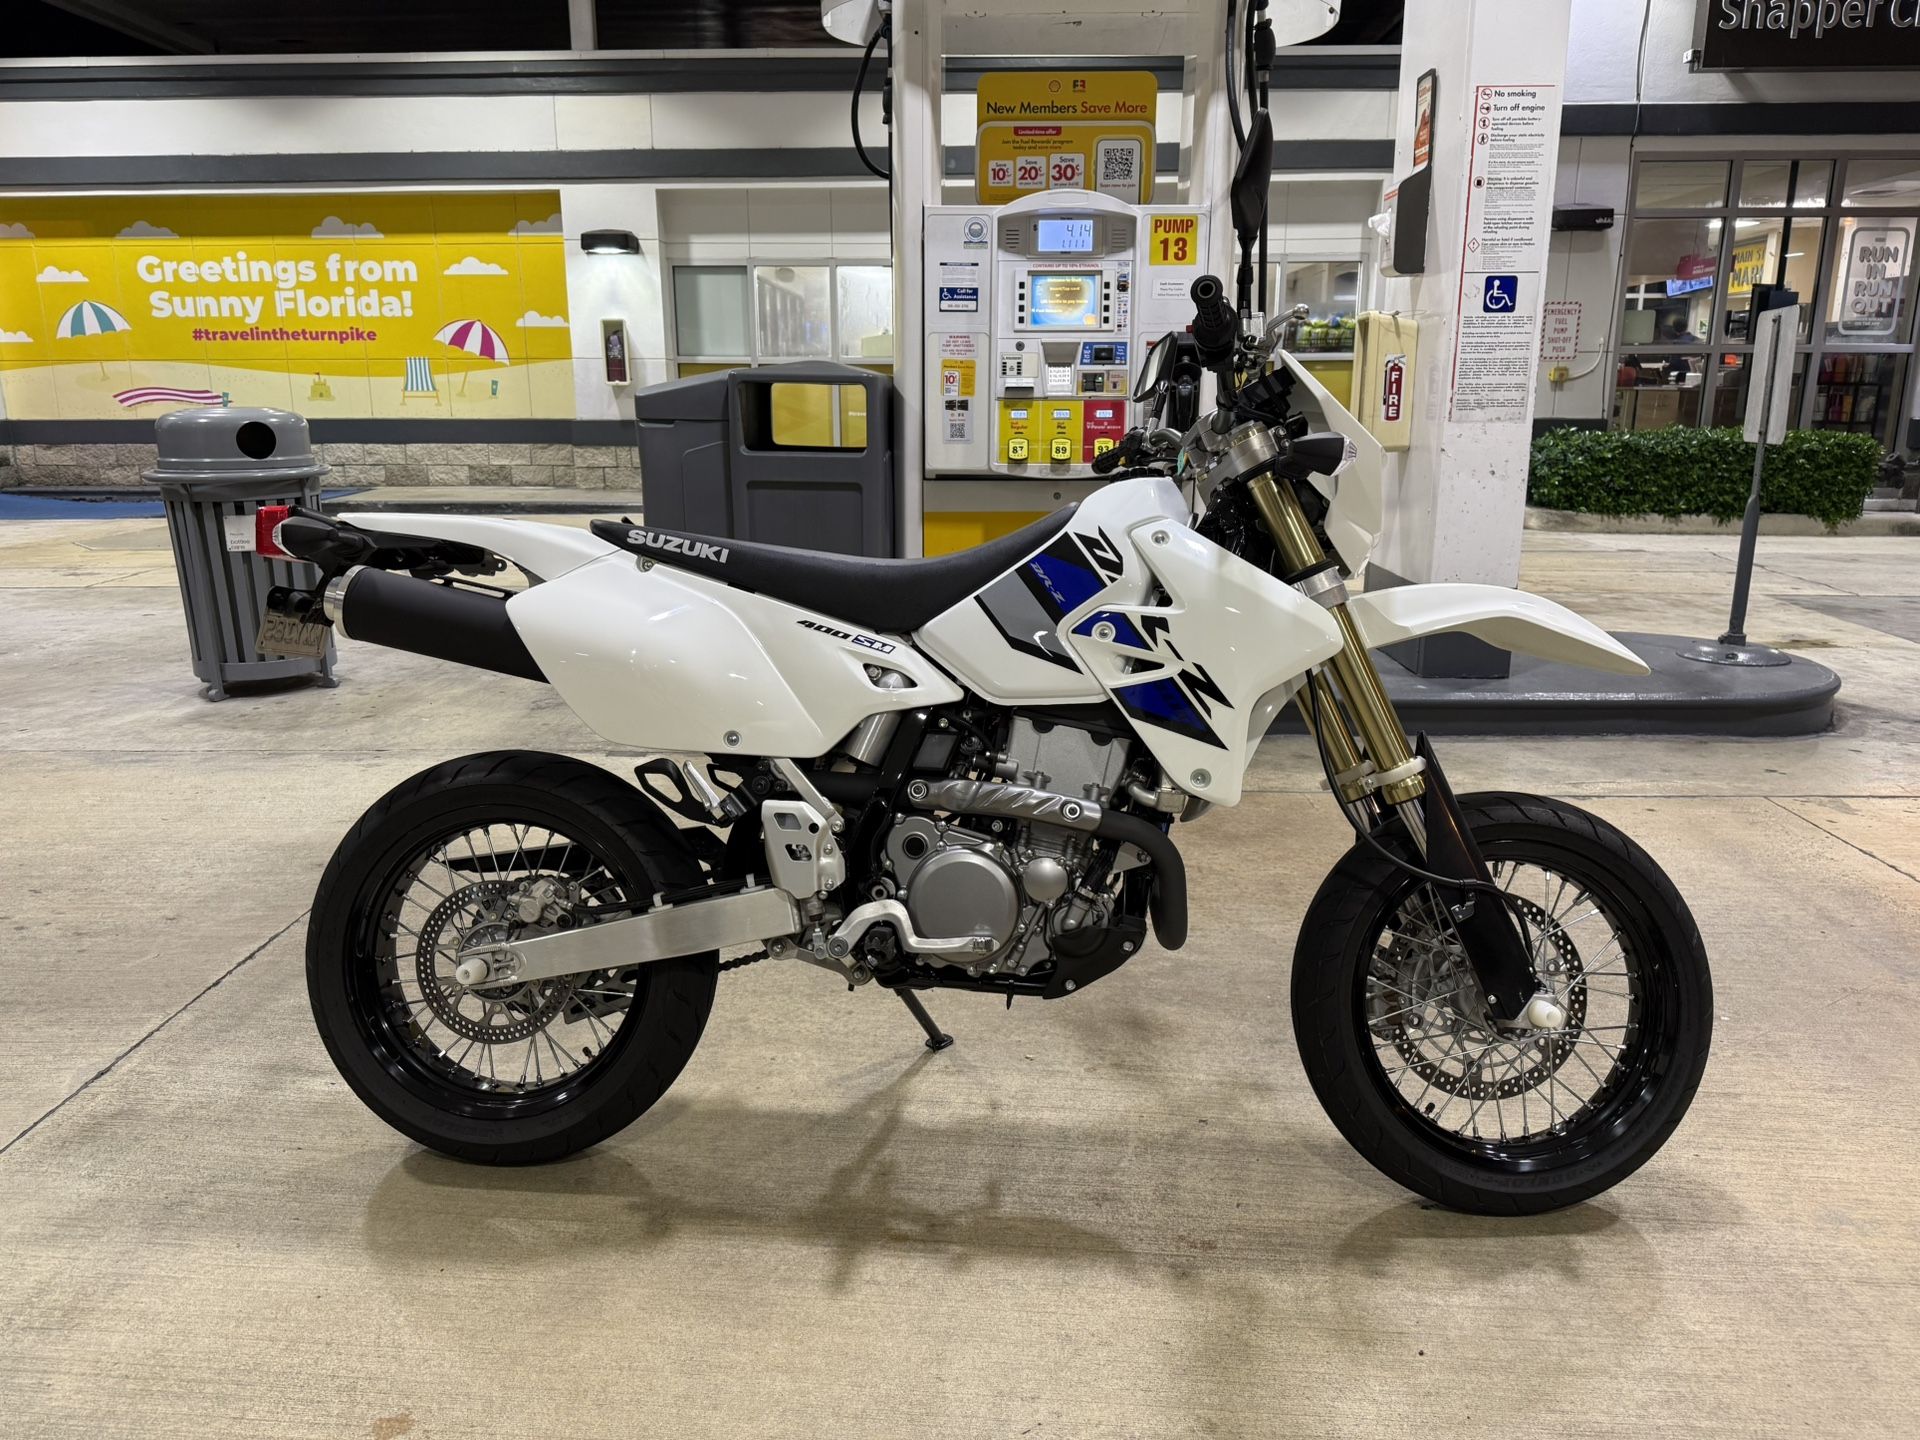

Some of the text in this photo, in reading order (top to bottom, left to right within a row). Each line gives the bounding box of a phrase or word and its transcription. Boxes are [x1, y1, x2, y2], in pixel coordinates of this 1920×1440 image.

[1718, 0, 1884, 39] Snapper
[1507, 90, 1536, 98] smoking
[986, 101, 1147, 114] New Members Save More
[1154, 220, 1193, 233] PUMP
[1160, 238, 1187, 261] 13
[1859, 246, 1899, 263] RUN
[137, 251, 417, 289] Greetings from
[1866, 264, 1886, 280] IN
[1855, 281, 1892, 297] RUN
[150, 287, 413, 324] Sunny Florida!
[193, 326, 376, 344] #travelintheturnpike
[1388, 372, 1400, 416] FIRE
[627, 530, 729, 563] SUZUKI
[1030, 562, 1066, 603] DR-Z
[796, 620, 896, 654] 400 SM
